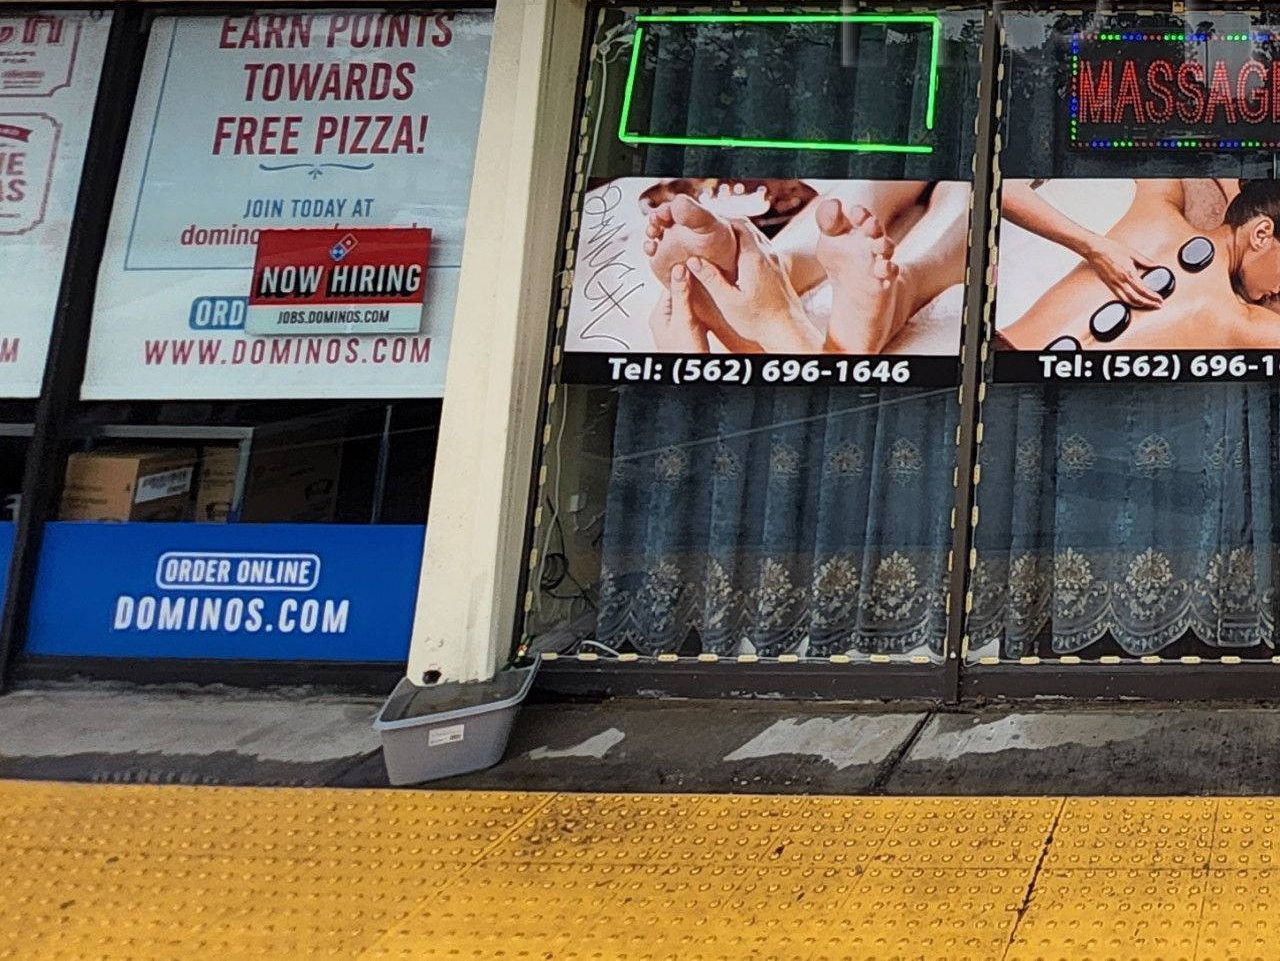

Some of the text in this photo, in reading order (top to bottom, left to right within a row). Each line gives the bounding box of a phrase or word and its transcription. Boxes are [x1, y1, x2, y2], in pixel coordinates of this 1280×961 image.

[218, 13, 454, 49] EARN POINTS
[244, 61, 416, 102] TOWARDS
[212, 114, 429, 155] FREE PIZZA!
[243, 198, 375, 219] JOIN TODAY AT
[260, 263, 423, 295] NOW HIRING
[194, 299, 246, 327] ORD
[276, 309, 389, 325] JOBS.DOMINOS.COM
[144, 337, 432, 365] WWW.DOMINOS.COM
[608, 358, 910, 384] Tel: (562) 696-1646
[1039, 355, 1093, 378] Tel:
[1102, 354, 1181, 381] (562)
[165, 558, 310, 585] ORDER ONLINE
[113, 595, 350, 634] DOMINOS.COM
